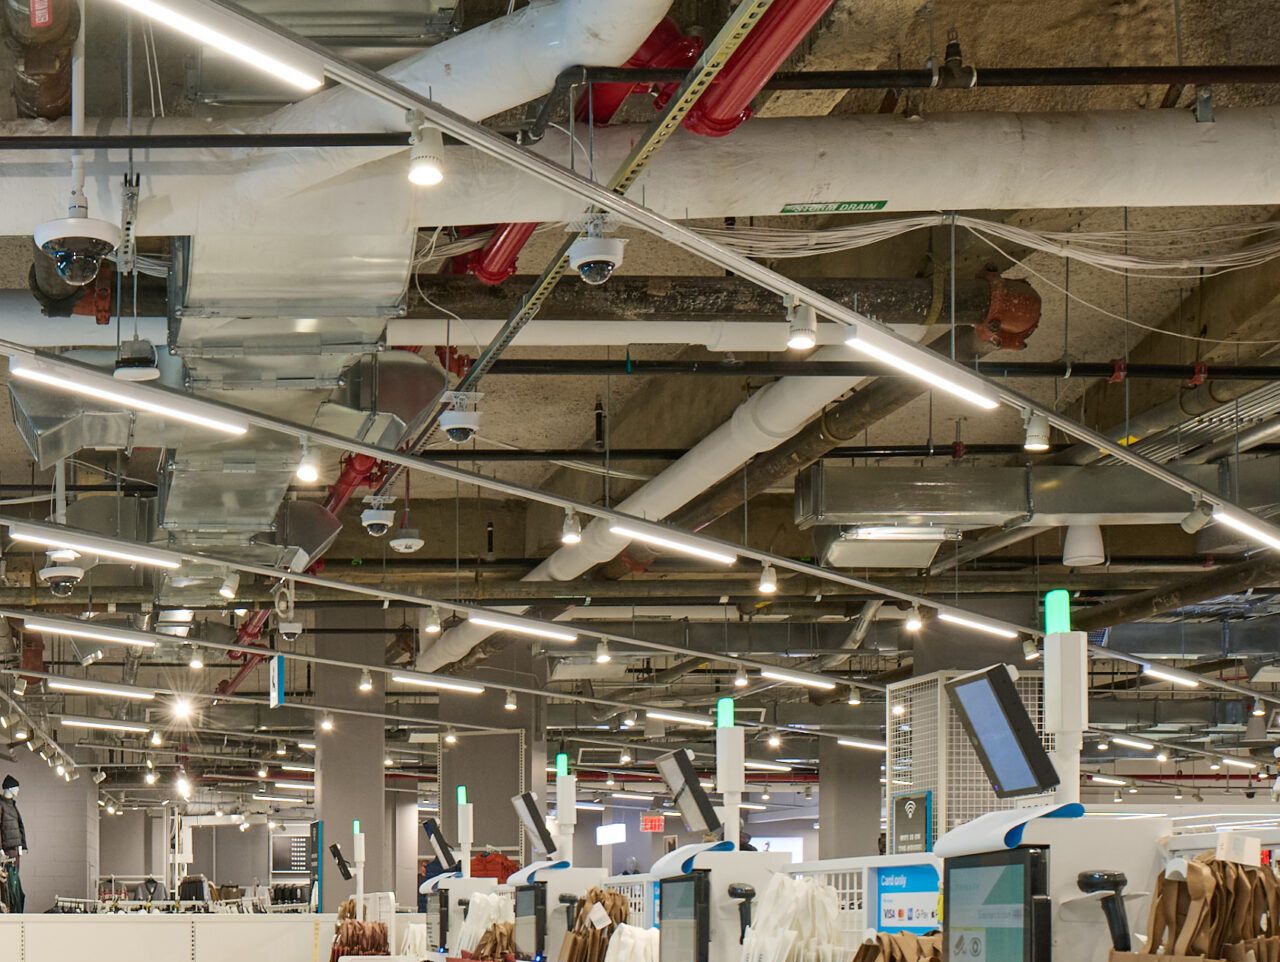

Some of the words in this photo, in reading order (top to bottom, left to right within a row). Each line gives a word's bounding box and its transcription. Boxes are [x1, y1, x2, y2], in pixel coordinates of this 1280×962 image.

[839, 203, 877, 211] DRAIN
[644, 817, 661, 830] EXIT
[881, 874, 894, 886] Card
[895, 874, 907, 888] only
[883, 908, 896, 919] VISA
